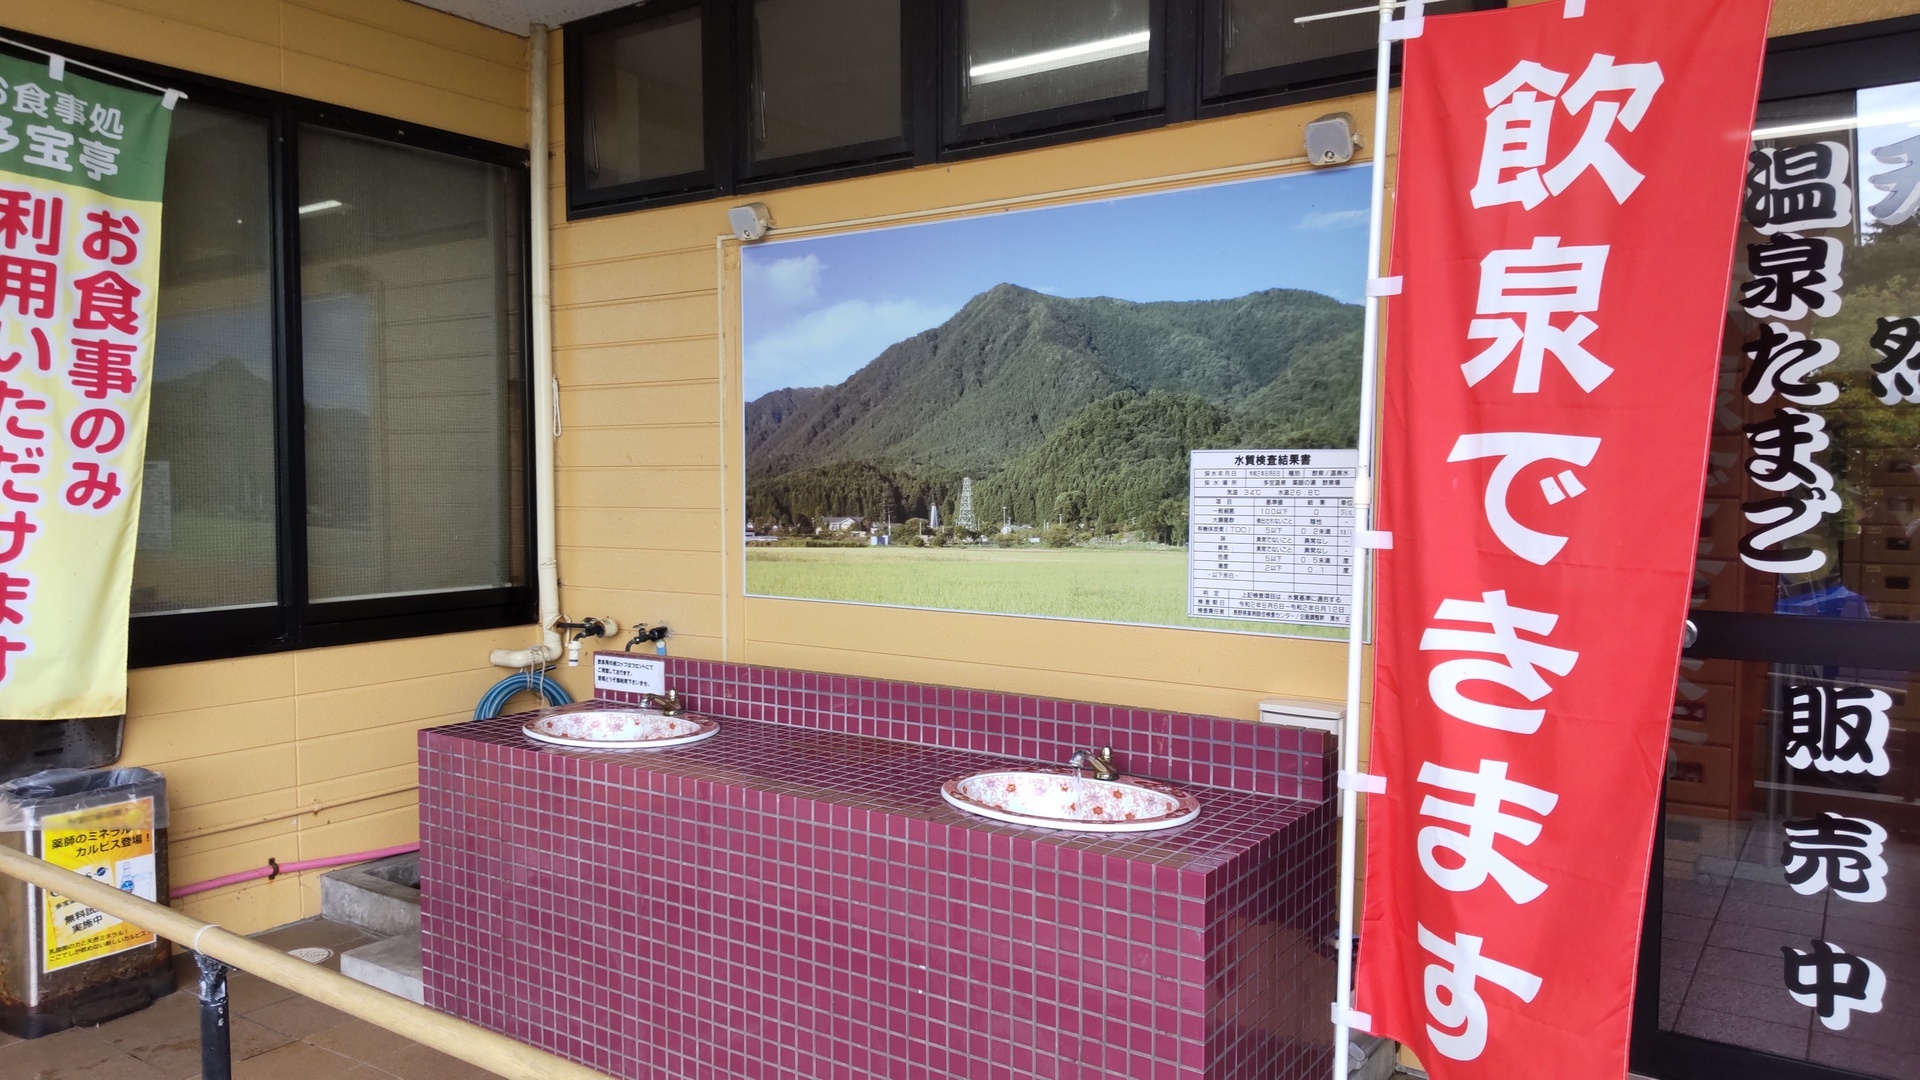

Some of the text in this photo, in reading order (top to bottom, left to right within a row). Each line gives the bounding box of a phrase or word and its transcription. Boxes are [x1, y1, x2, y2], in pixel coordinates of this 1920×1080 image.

[65, 210, 141, 510] お食事のみ
[1234, 454, 1311, 466] 水質検査結果書
[1739, 141, 1849, 573] 温泉たまご
[1417, 52, 1664, 1062] 飲泉できます
[64, 906, 99, 926] 無料試
[72, 914, 103, 934] 実施中
[1781, 685, 1892, 1030] 販売中
